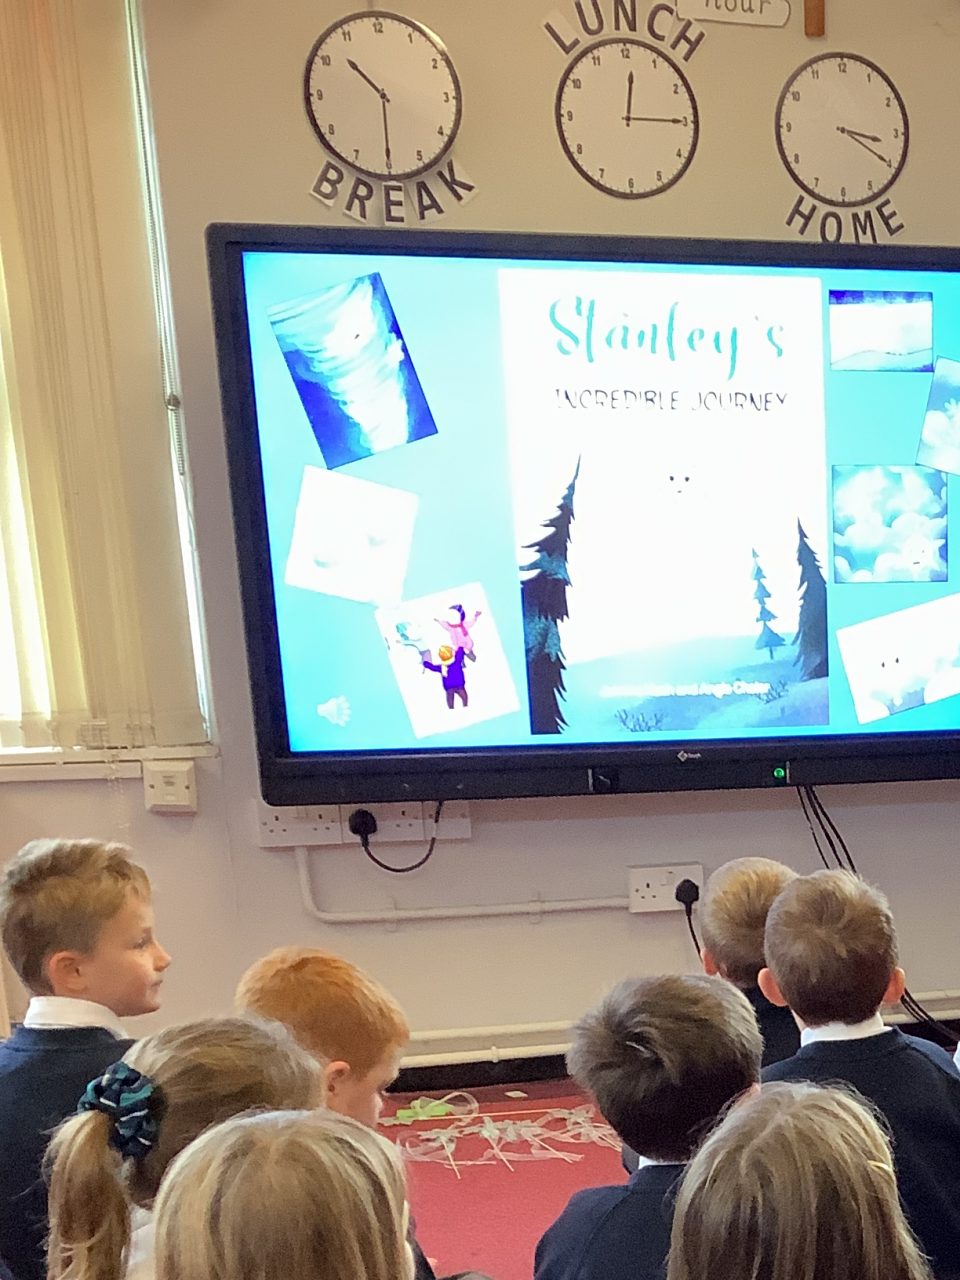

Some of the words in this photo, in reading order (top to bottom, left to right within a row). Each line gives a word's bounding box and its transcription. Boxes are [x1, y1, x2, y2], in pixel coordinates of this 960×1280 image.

[373, 22, 383, 33] 12
[544, 0, 705, 62] LUNCH
[342, 31, 351, 41] 11
[408, 33, 413, 43] 1
[621, 49, 630, 58] 12
[321, 55, 331, 66] 10
[432, 59, 437, 69] 2
[592, 56, 600, 65] 11
[652, 59, 656, 68] 1
[838, 63, 847, 73] 12
[812, 70, 819, 79] 11
[867, 73, 871, 83] 1
[573, 79, 581, 89] 10
[673, 84, 678, 94] 2
[317, 89, 323, 100] 9
[443, 92, 449, 102] 3
[792, 91, 800, 101] 10
[886, 97, 891, 107] 2
[567, 111, 573, 121] 9
[682, 117, 688, 126] 3
[328, 124, 334, 135] 8
[437, 125, 444, 136] 4
[786, 122, 791, 132] 9
[894, 129, 898, 138] 3
[577, 144, 582, 154] 8
[676, 148, 681, 158] 4
[353, 150, 359, 160] 7
[417, 150, 422, 160] 5
[794, 154, 799, 164] 8
[887, 159, 892, 168] 4
[599, 168, 604, 178] 7
[656, 171, 662, 181] 5
[628, 178, 634, 188] 6
[814, 178, 819, 187] 7
[868, 181, 872, 190] 5
[312, 159, 475, 223] BREAK
[841, 187, 846, 197] 6
[785, 194, 905, 244] HOME
[550, 296, 784, 380] Stanley's
[555, 388, 679, 410] INCREDIBLE
[692, 391, 788, 411] JOURNEY
